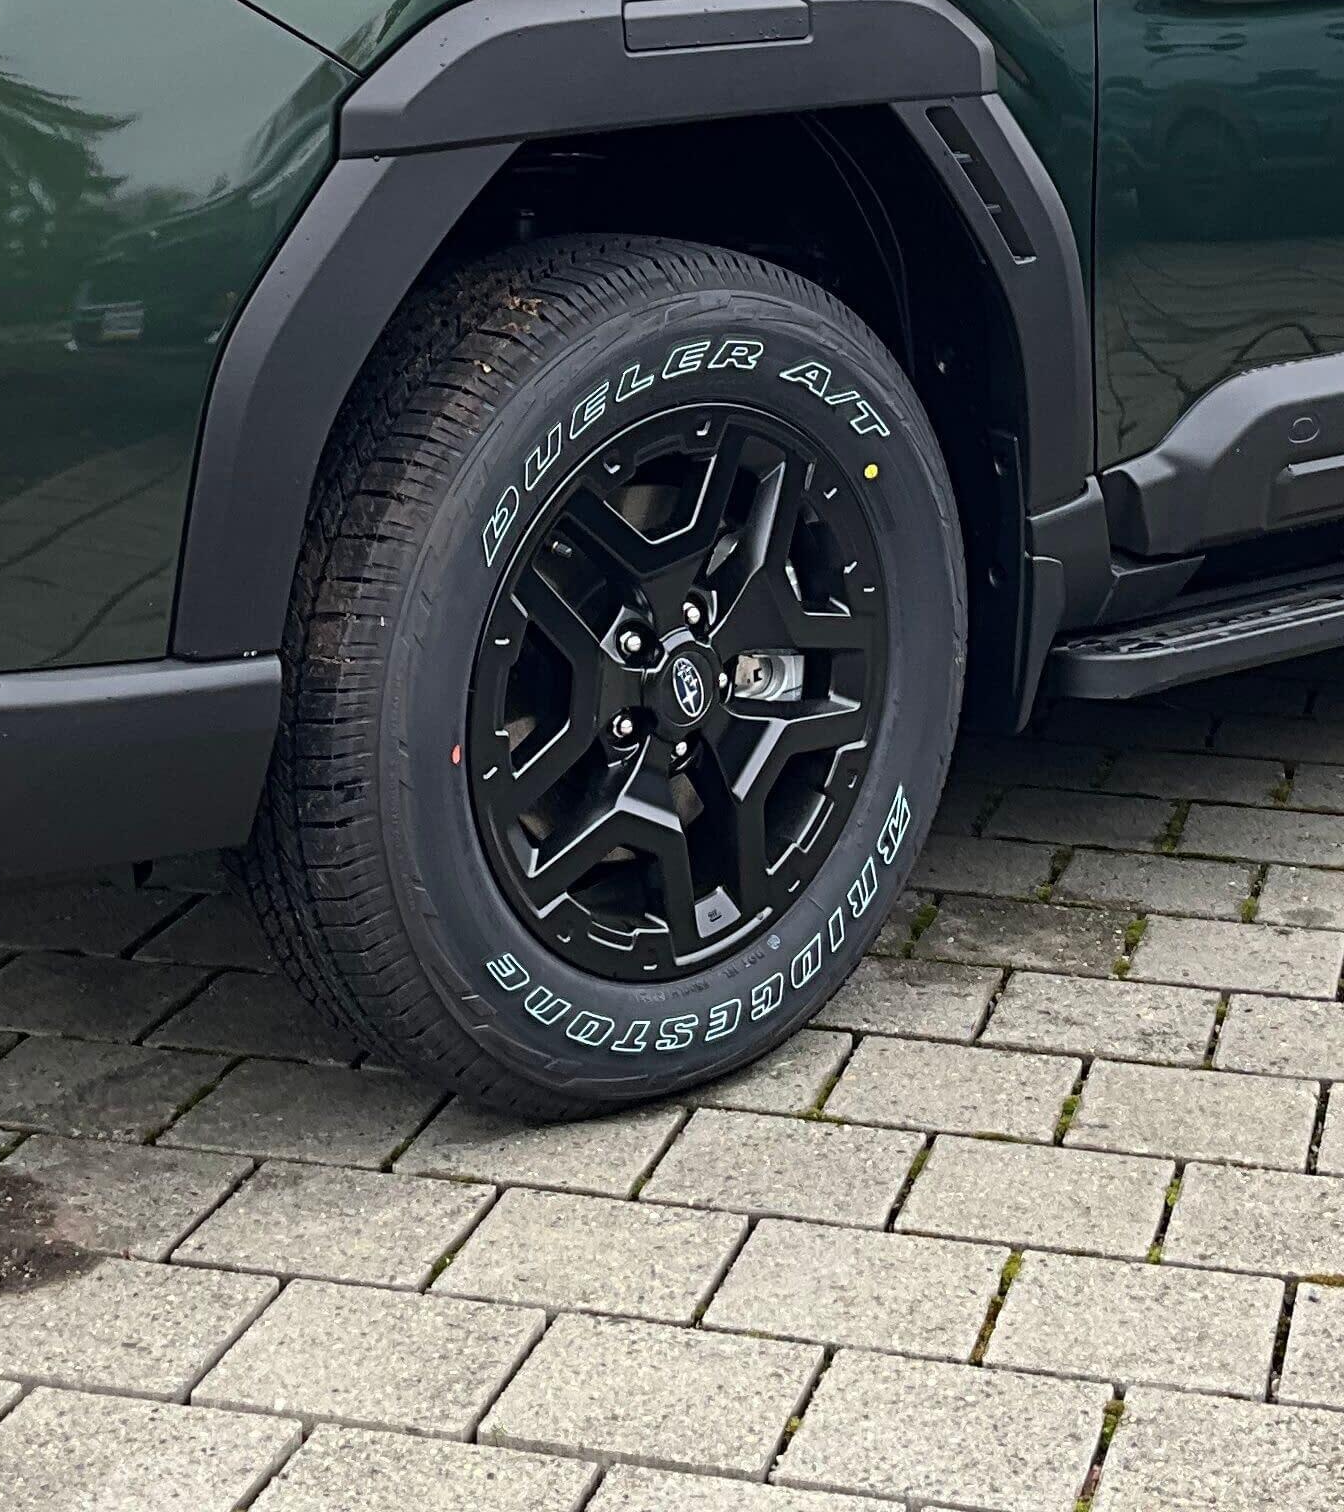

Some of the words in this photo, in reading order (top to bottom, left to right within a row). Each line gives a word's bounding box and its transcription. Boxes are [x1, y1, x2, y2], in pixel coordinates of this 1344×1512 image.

[481, 339, 764, 568] DUELER
[778, 360, 891, 439] A/T
[485, 782, 912, 1054] BRIDGESTONE
